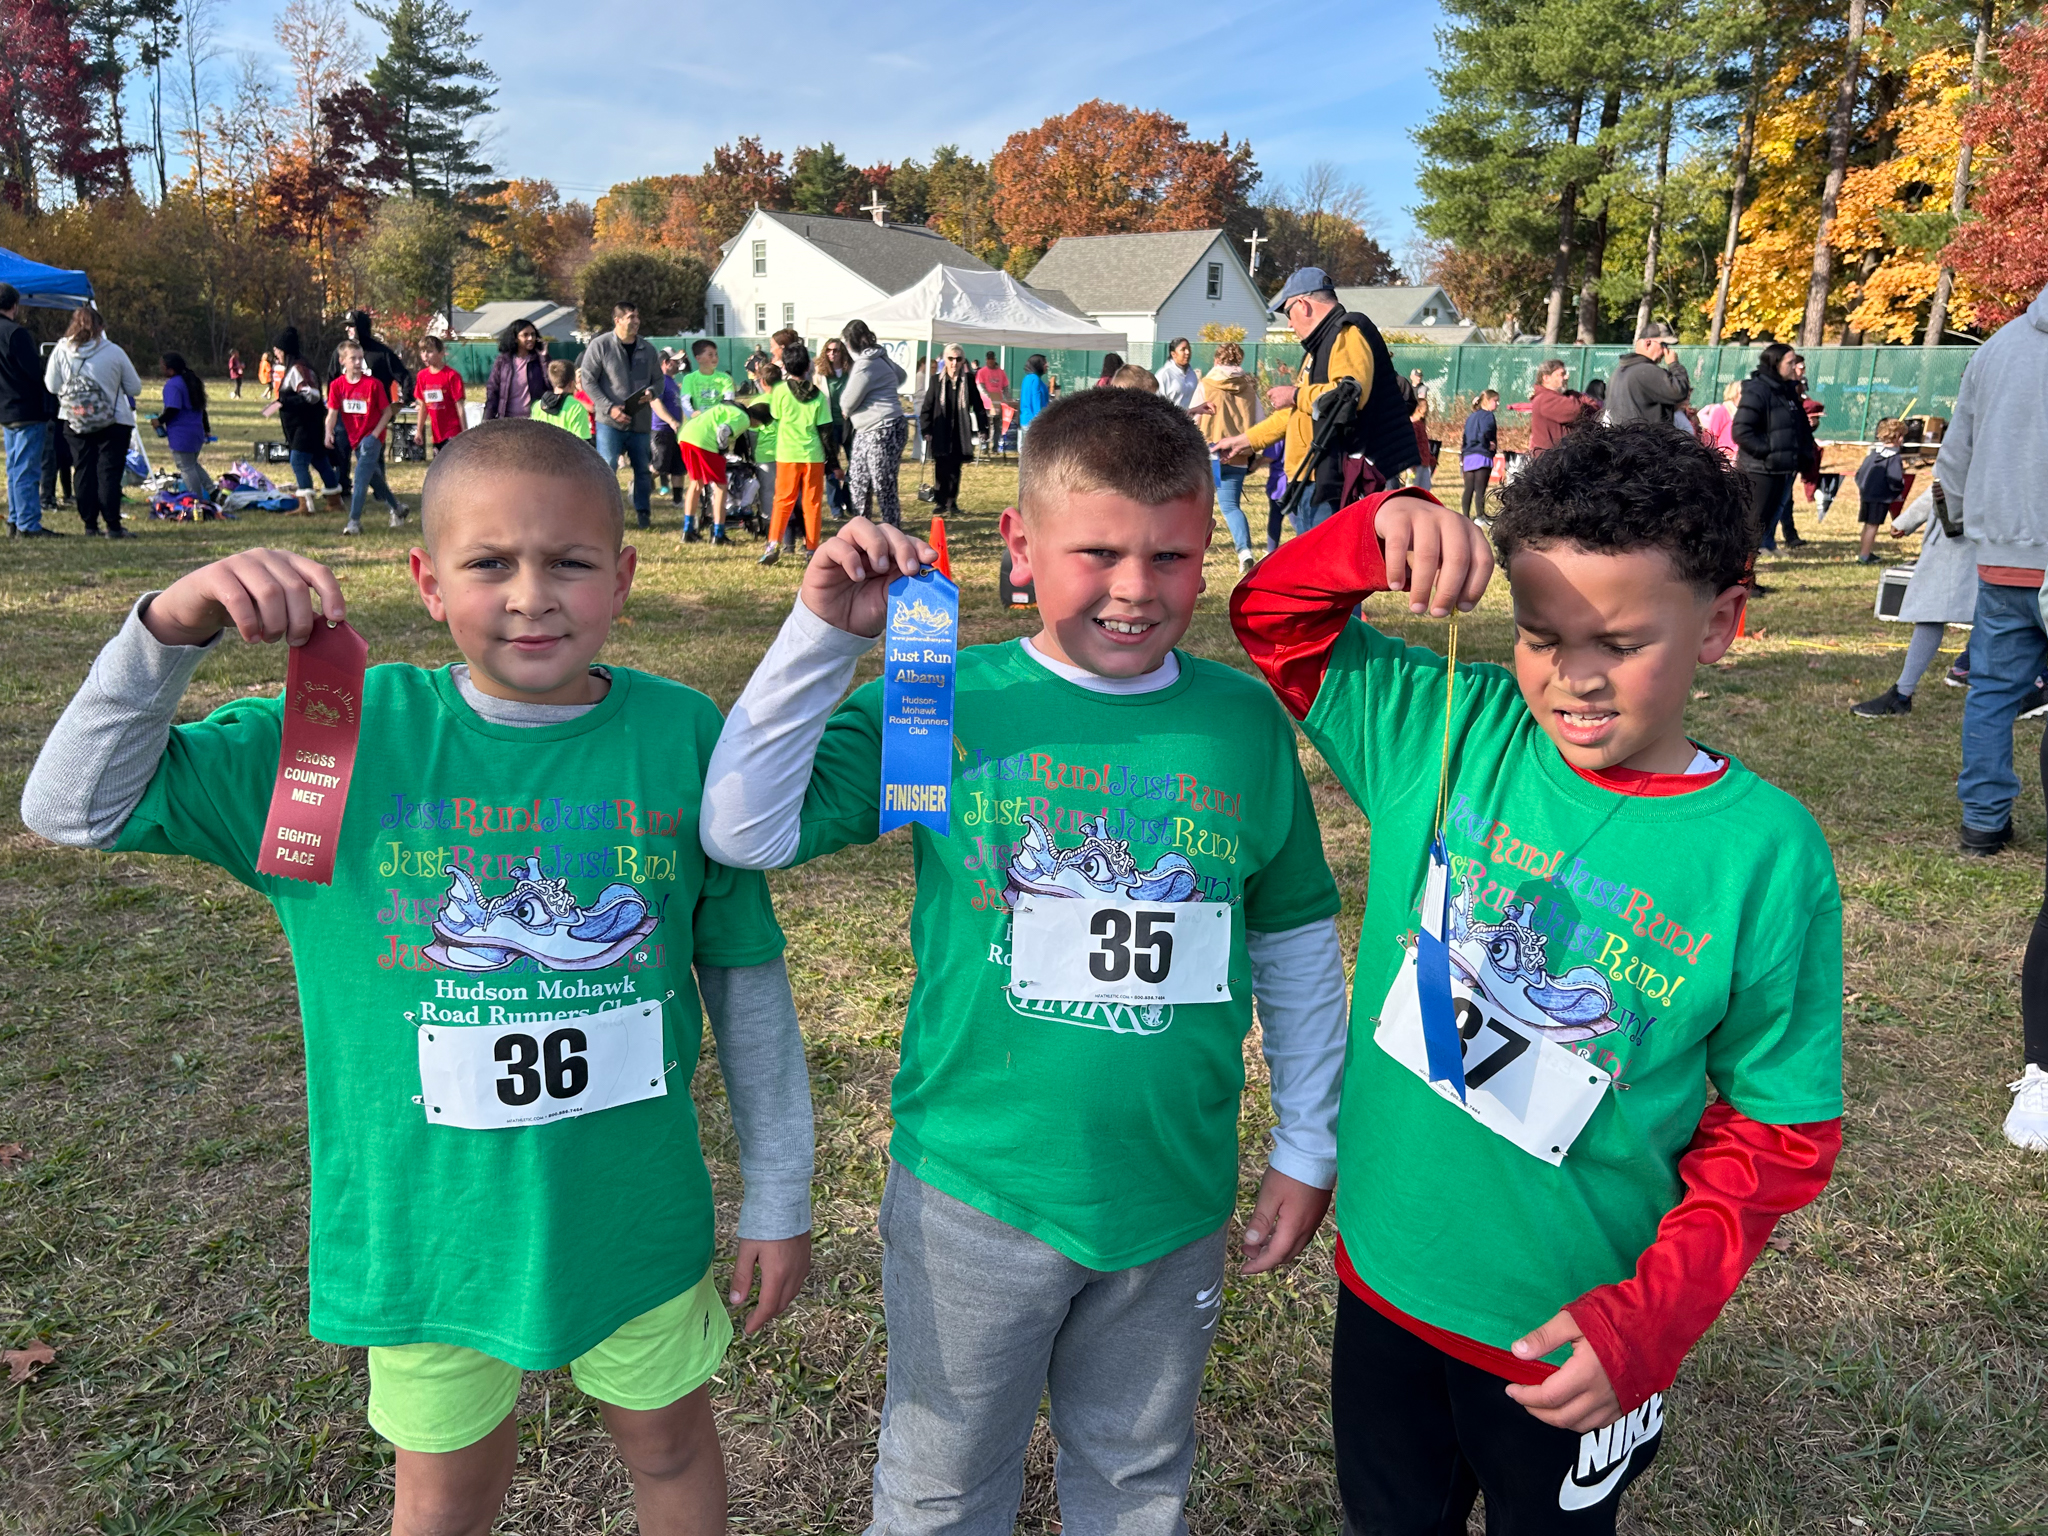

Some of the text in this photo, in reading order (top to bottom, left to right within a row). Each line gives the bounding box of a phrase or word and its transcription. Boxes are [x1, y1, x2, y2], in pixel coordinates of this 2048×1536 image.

[890, 648, 952, 664] Just Run
[894, 669, 946, 688] Albany
[304, 681, 329, 693] Run
[333, 687, 355, 725] Albany
[901, 695, 938, 705] Hudson-
[901, 706, 937, 715] Mohawk
[889, 715, 949, 726] Road Runners
[908, 726, 929, 735] Club
[295, 749, 335, 769] CROSS
[284, 766, 340, 789] COUNTRY
[291, 787, 325, 807] MEET
[885, 783, 947, 812] FINISHER
[277, 826, 322, 848] EIGHTH
[275, 846, 316, 866] PLACE
[1089, 908, 1176, 984] 35
[434, 974, 637, 1001] Hudson Mohawk
[420, 1001, 481, 1025] Road
[494, 1027, 589, 1107] 36
[1576, 1392, 1664, 1480] NIKE
